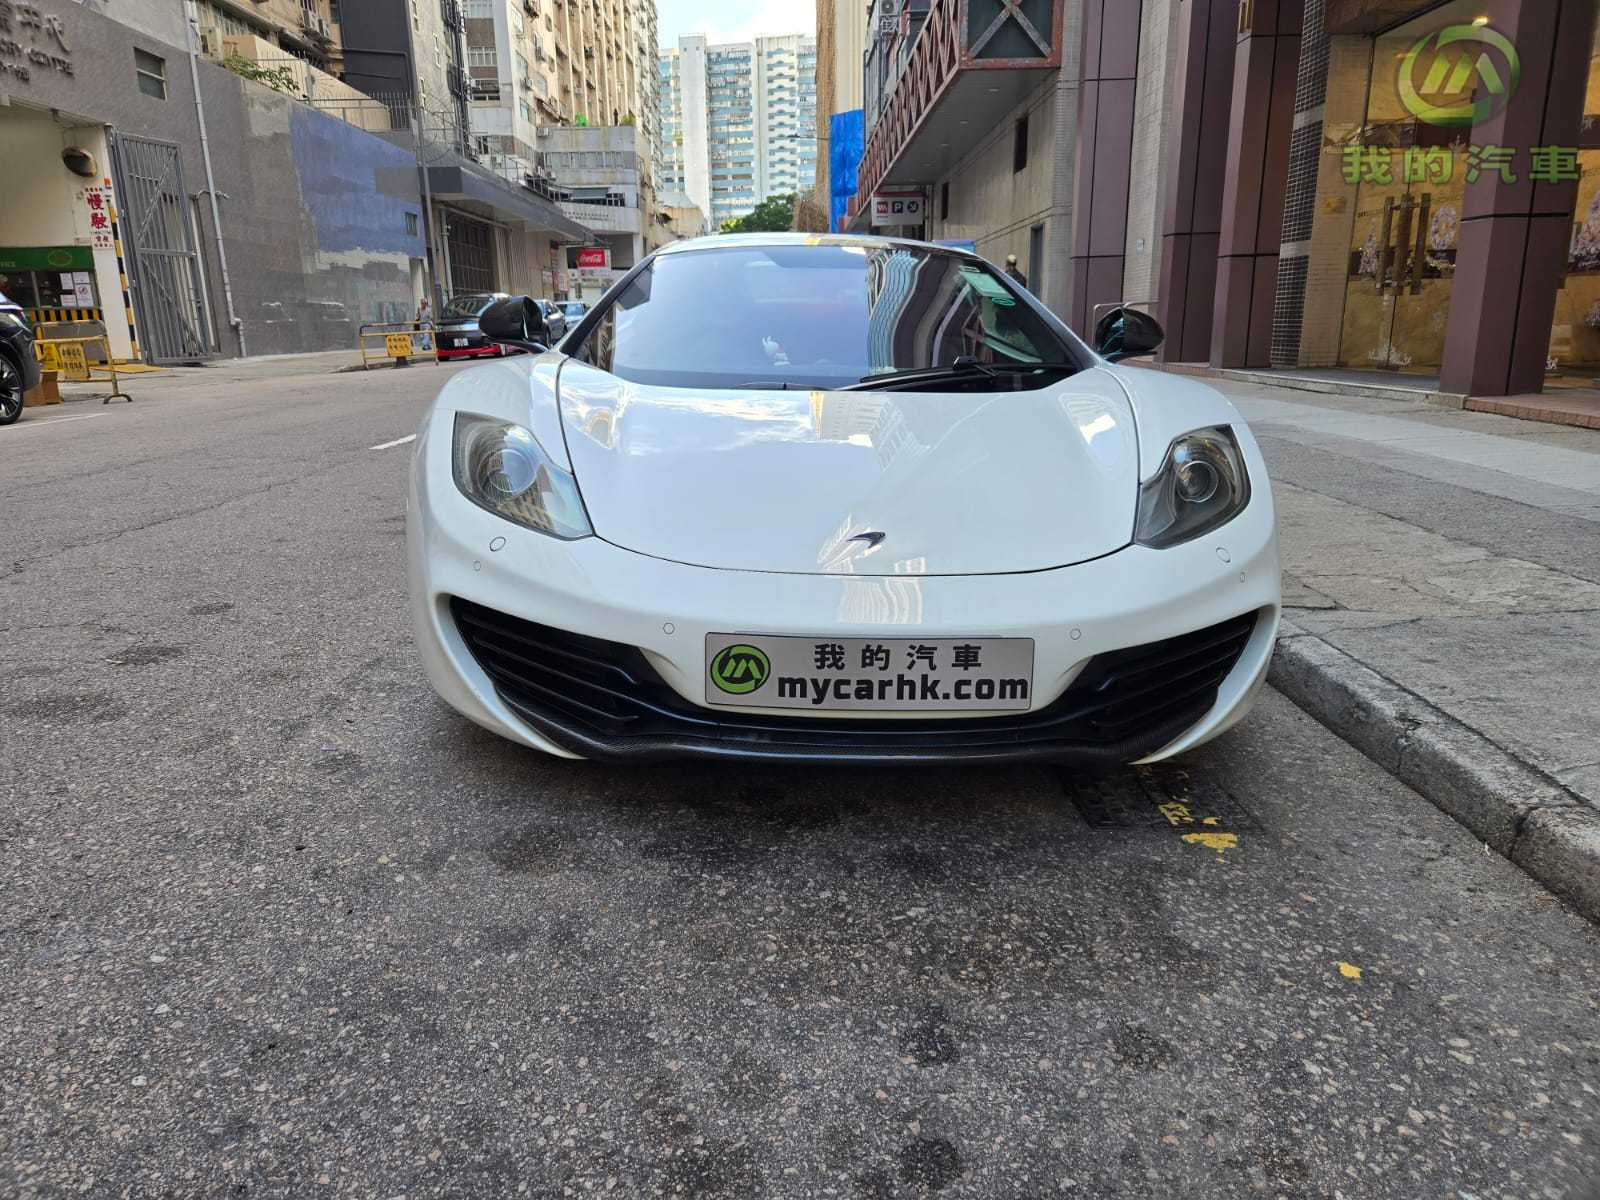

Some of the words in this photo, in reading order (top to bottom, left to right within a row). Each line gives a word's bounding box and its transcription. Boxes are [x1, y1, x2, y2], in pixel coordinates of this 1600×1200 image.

[87, 193, 108, 230] 慢駛
[813, 643, 982, 671] 我的汽車
[777, 674, 1028, 704] mycarhk.com
